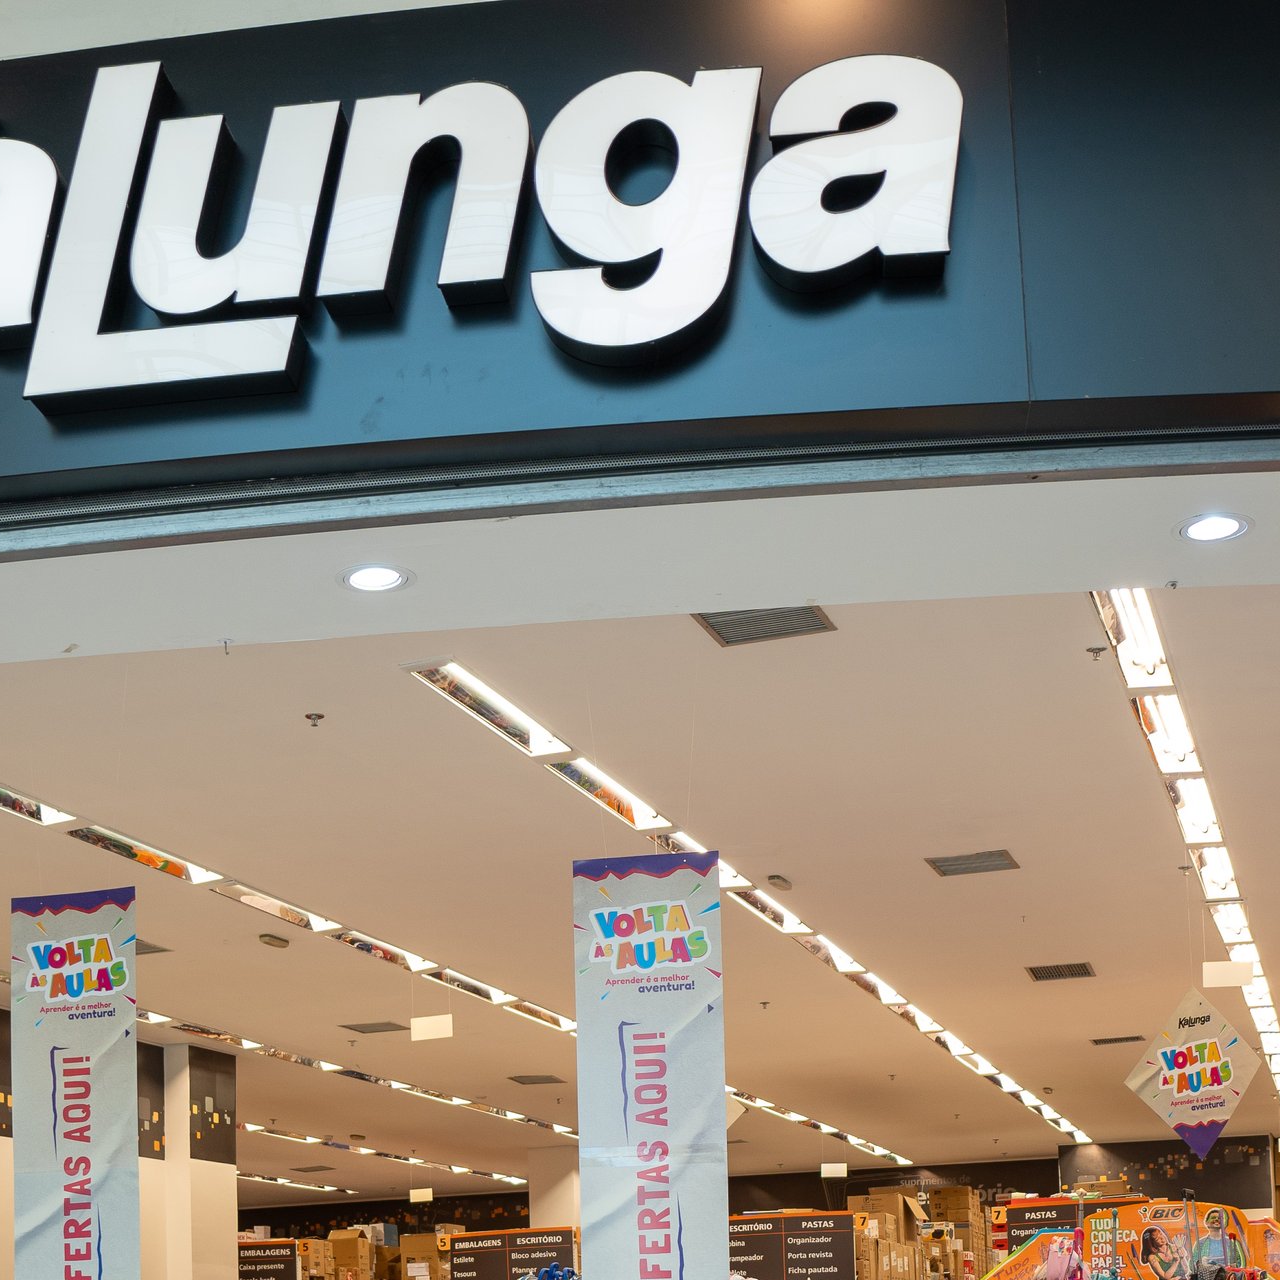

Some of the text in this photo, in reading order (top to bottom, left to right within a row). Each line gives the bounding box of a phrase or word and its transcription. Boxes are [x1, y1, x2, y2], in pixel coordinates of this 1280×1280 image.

[595, 904, 690, 940] VOLTA
[33, 937, 112, 971] VOLTA
[594, 930, 708, 971] ÀS AULAS
[50, 961, 127, 1000] AULAS
[605, 973, 690, 987] Aprender melhor
[40, 1002, 111, 1015] Aprender melhor
[68, 1008, 116, 1020] aventura!
[1161, 1042, 1221, 1071] VOLTA
[633, 1032, 669, 1127] AQUI!
[1177, 1061, 1231, 1094] AULAS
[63, 1055, 91, 1143] AQUI!
[1025, 1210, 1057, 1219] PASTAS
[801, 1219, 834, 1229] PASTAS
[859, 1216, 867, 1227] 7
[455, 1239, 502, 1249] EMBALAGENS
[517, 1234, 562, 1244] ESCRITÓRIO
[787, 1235, 832, 1245] Organizador
[240, 1248, 290, 1257] EMBALAGENS
[529, 1251, 557, 1259] adesivo
[788, 1250, 833, 1260] Porta revista
[257, 1263, 284, 1272] presente
[788, 1265, 837, 1275] Ficha pautada
[454, 1270, 476, 1278] Tesoura
